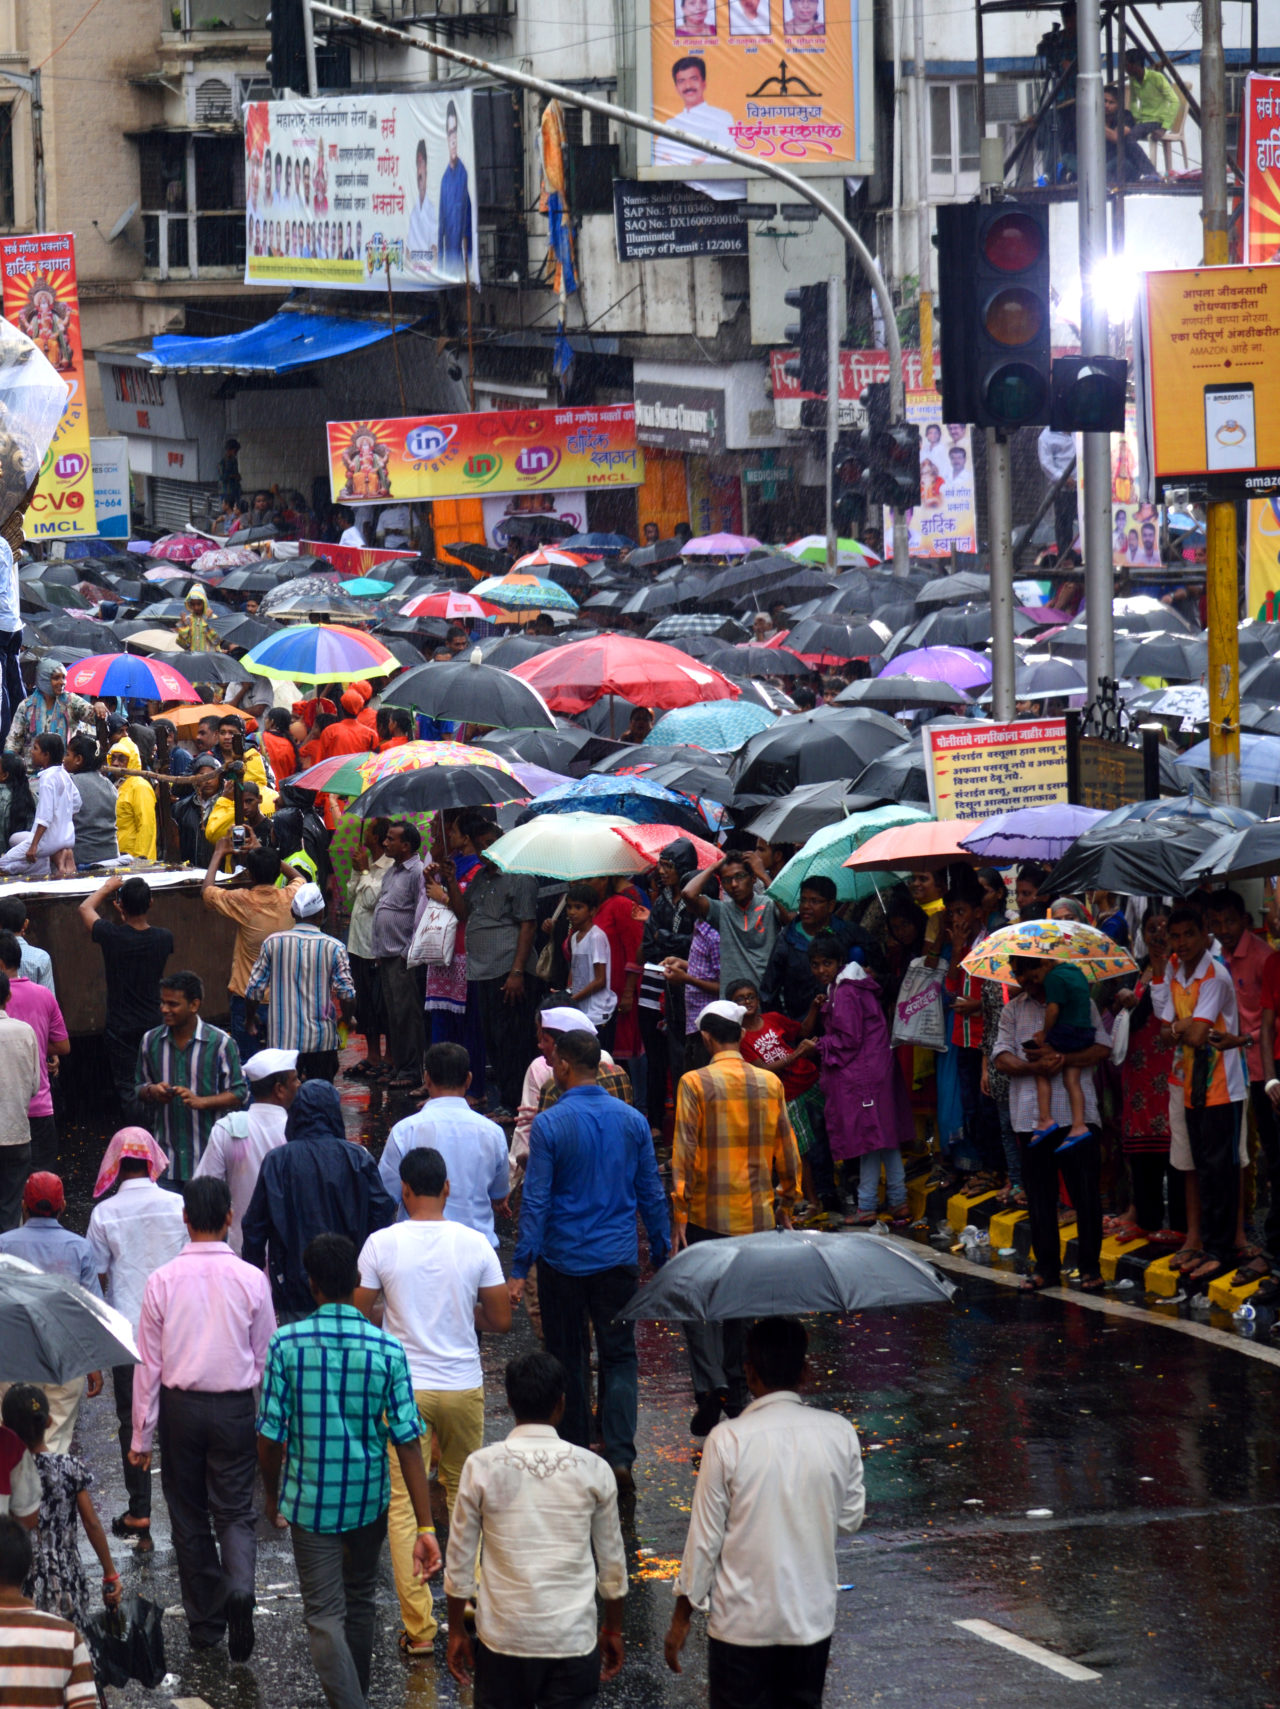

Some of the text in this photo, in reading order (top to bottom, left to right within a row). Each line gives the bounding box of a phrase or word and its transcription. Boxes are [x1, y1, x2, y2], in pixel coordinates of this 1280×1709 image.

[746, 102, 822, 122] विभागप्रमुख
[1256, 88, 1273, 120] सर्व
[381, 107, 397, 140] सर्व
[377, 148, 399, 178] गणेश
[372, 184, 405, 216] भक्तांचे
[623, 196, 649, 205] Name:
[624, 207, 644, 218] SAP
[624, 220, 647, 231] SAQ
[625, 231, 675, 243] Illuminated
[4, 241, 18, 255] सर्व
[626, 245, 656, 258] Expiry
[658, 243, 667, 254] of
[669, 241, 698, 254] Permit
[706, 240, 742, 251] 12/2016
[5, 256, 71, 277] हार्दिक स्वागत
[1183, 283, 1267, 299] आपला जीवनसाथी
[1181, 314, 1213, 327] गणपती
[1170, 325, 1280, 343] एका परिपूर्ण अंगठीकरीत
[1190, 345, 1228, 355] AMAZON
[1231, 341, 1248, 354] आहे
[555, 411, 573, 424] सभी
[566, 426, 610, 454] हार्दिक
[587, 473, 631, 483] IMCL
[33, 521, 85, 534] IMCL
[921, 512, 956, 536] हार्दिक
[974, 727, 1018, 744] नागरिकांना
[1020, 726, 1042, 741] जाहीर
[1020, 746, 1035, 756] हात
